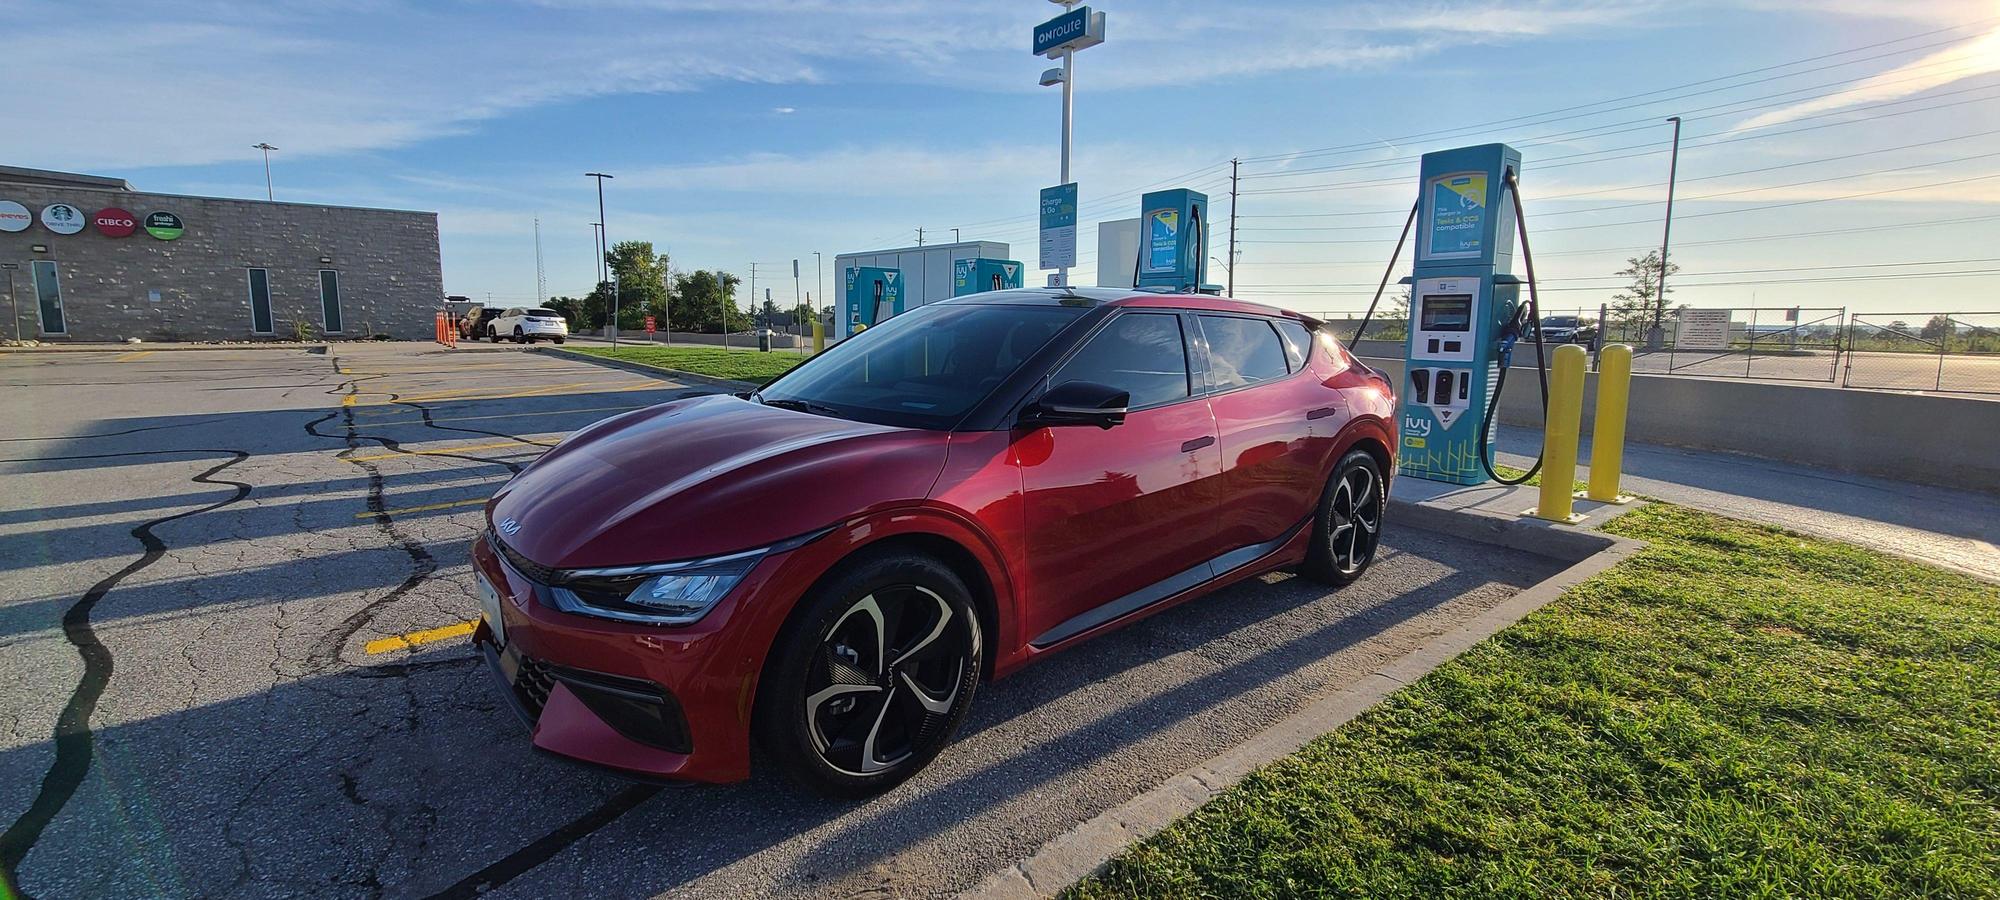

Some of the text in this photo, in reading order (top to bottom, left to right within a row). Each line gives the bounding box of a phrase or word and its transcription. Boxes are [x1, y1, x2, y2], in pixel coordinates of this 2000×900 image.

[1041, 198, 1062, 206] Charge
[1047, 206, 1056, 214] Go
[97, 218, 122, 227] CIBC
[1436, 222, 1475, 231] compatible
[956, 264, 967, 279] ivy
[886, 284, 897, 296] ivy
[1405, 413, 1431, 436] ivy
[500, 517, 522, 536] KIA
